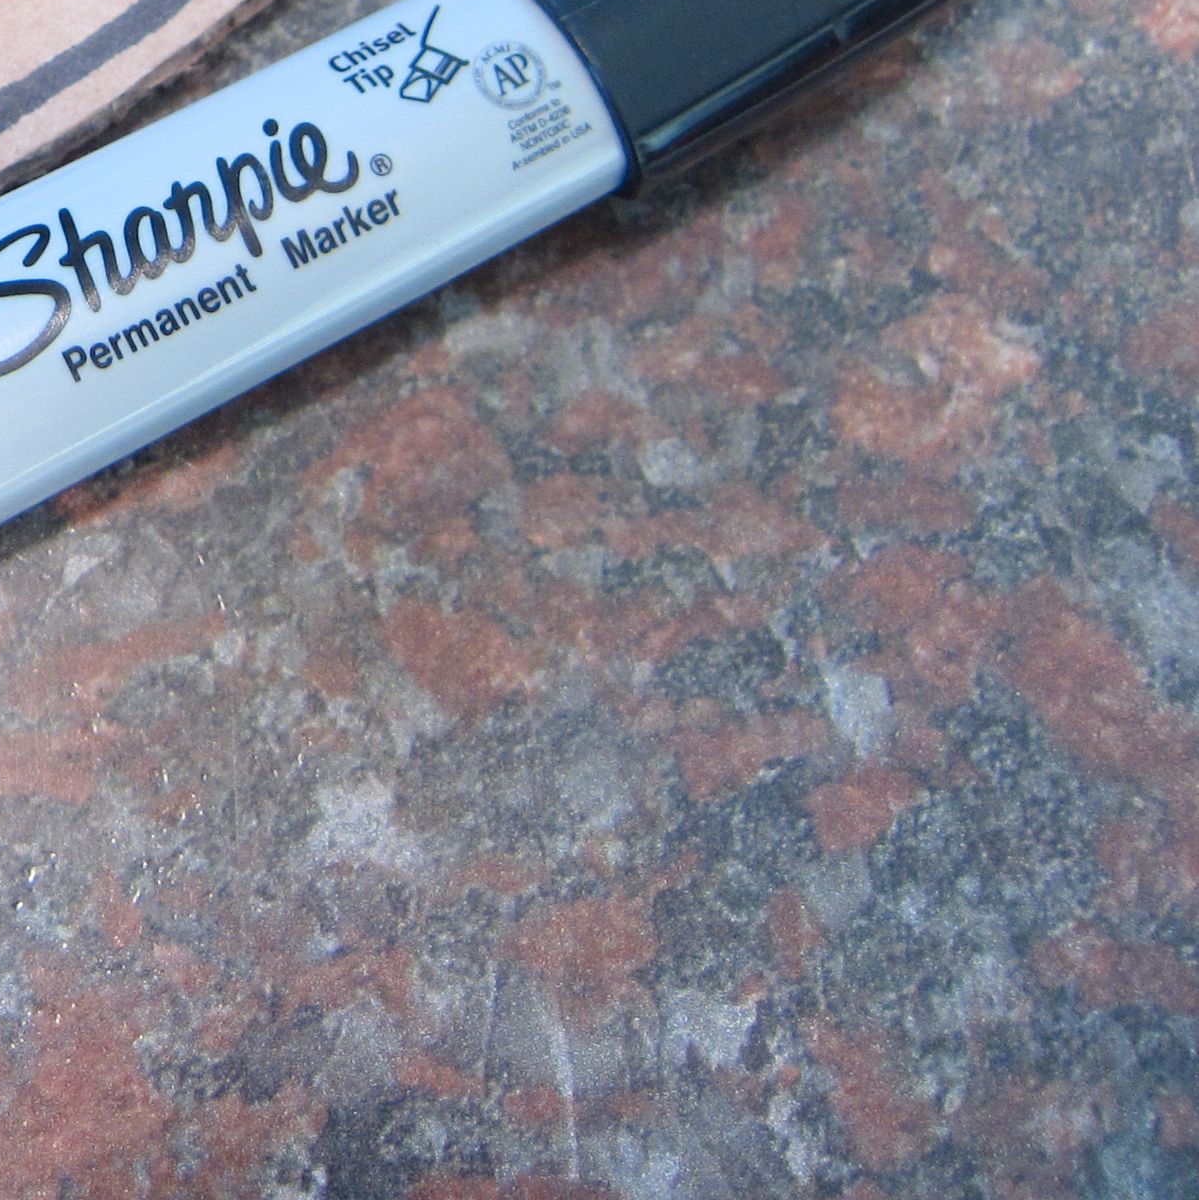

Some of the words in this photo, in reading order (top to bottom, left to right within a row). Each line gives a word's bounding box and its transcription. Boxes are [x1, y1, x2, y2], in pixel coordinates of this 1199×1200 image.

[328, 22, 417, 73] Chisel
[343, 64, 394, 94] Tip
[492, 53, 530, 96] AP
[510, 121, 538, 143] ASTM
[569, 122, 593, 140] USA
[61, 263, 257, 382] Permanent
[280, 189, 400, 269] Marker
